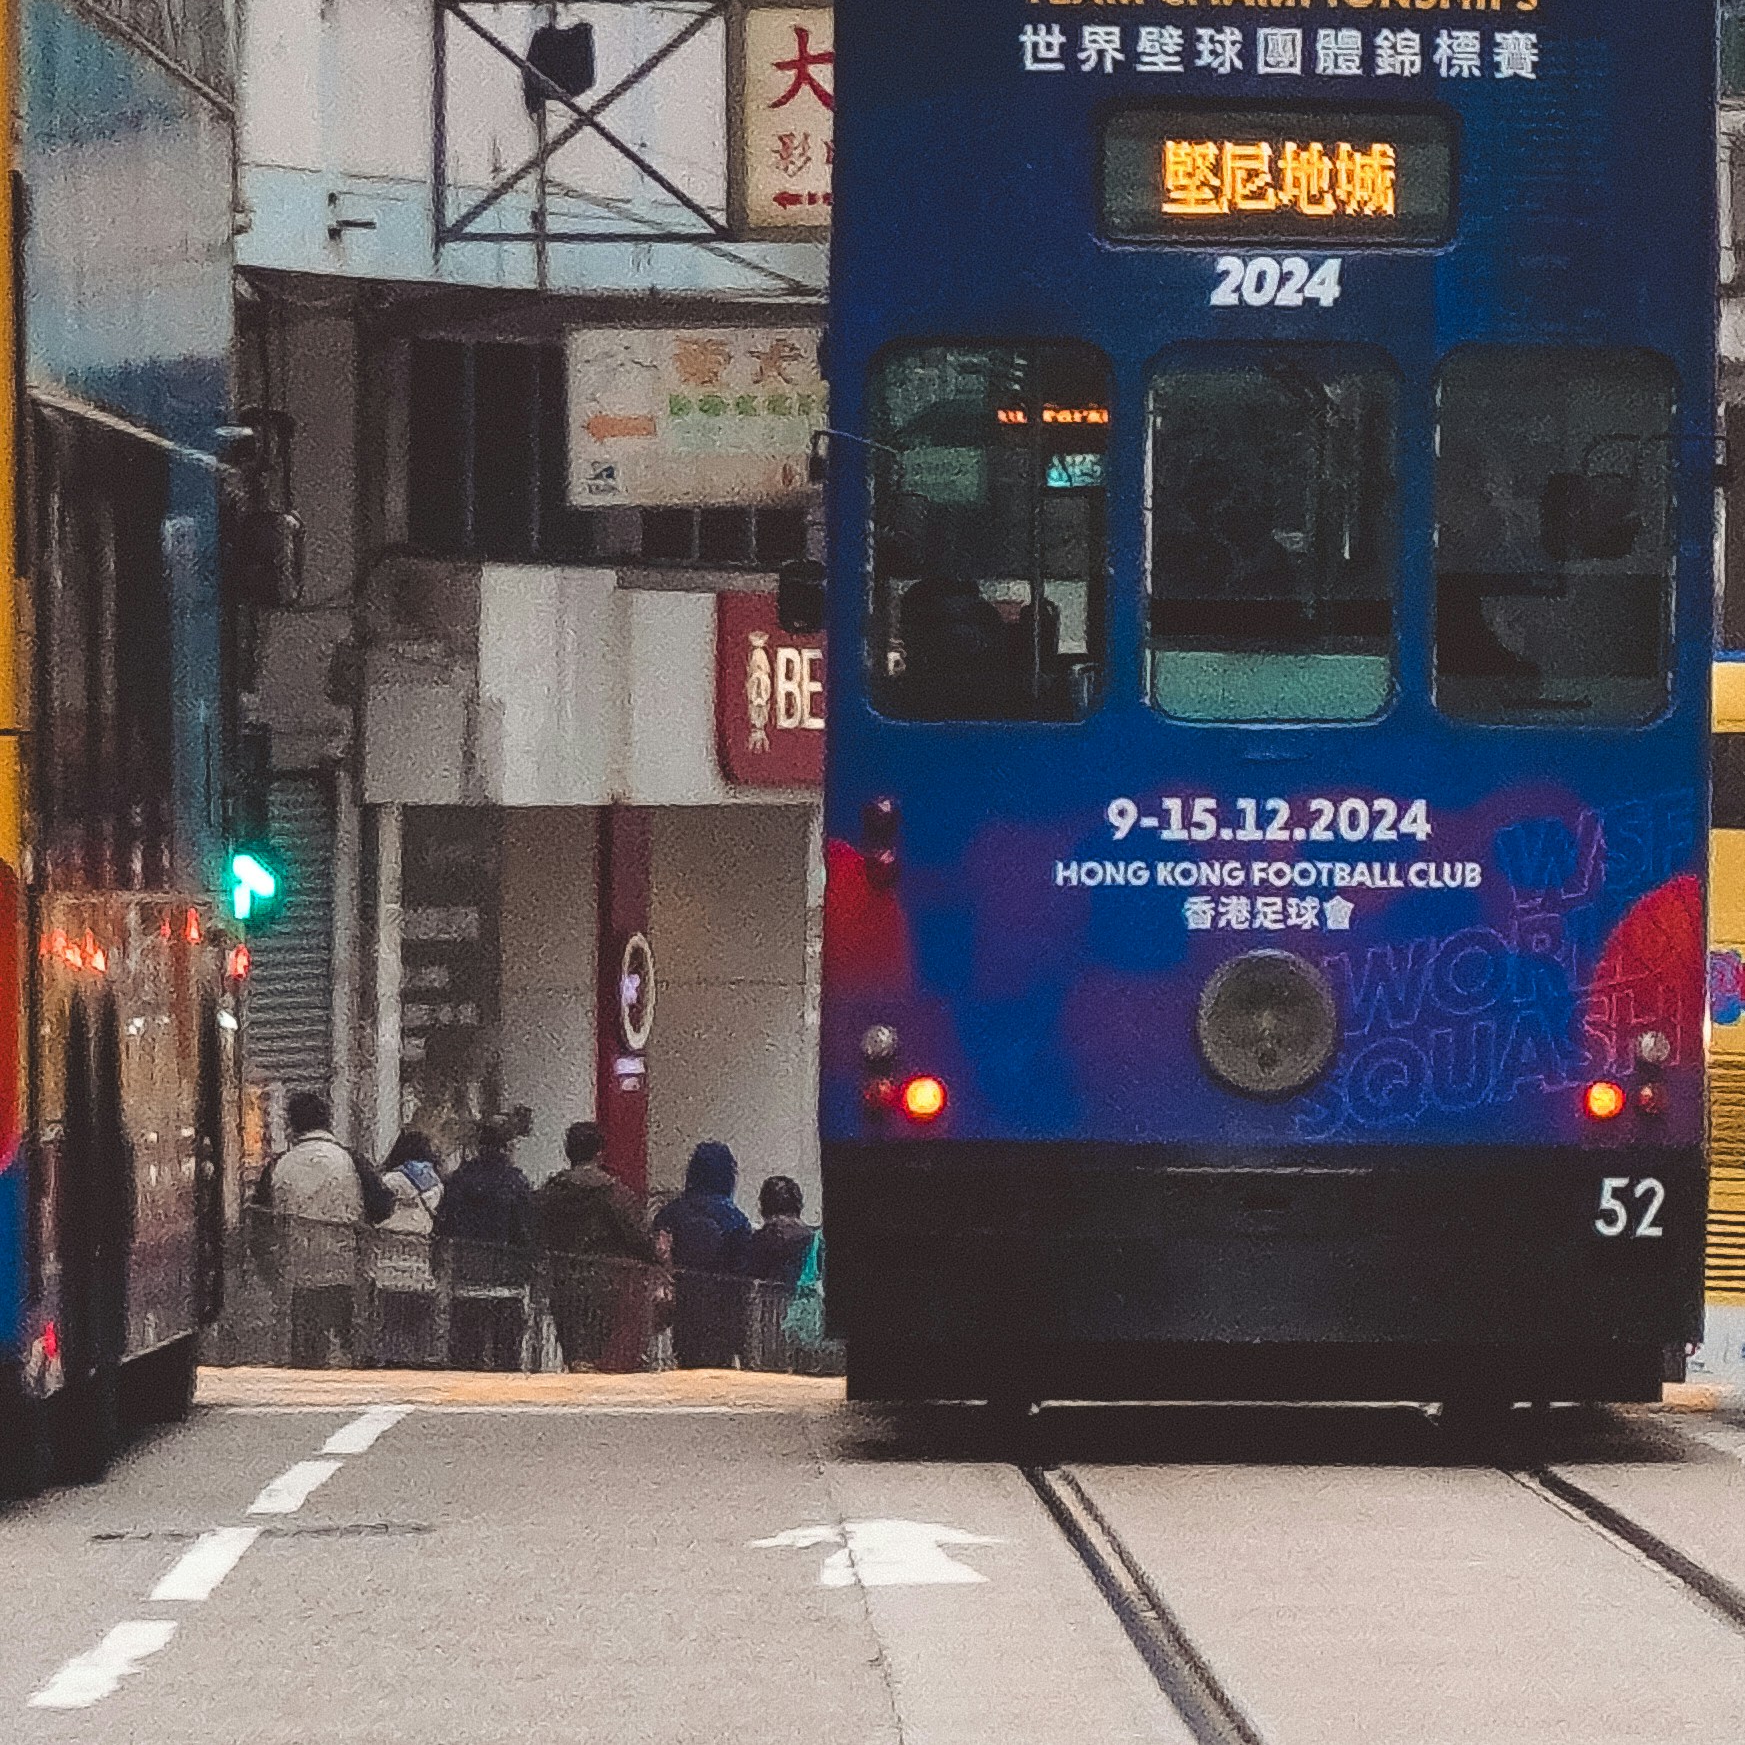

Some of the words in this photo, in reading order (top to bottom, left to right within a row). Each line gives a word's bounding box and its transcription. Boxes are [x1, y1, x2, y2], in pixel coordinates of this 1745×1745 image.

[1019, 23, 1538, 79] 世界壁球團體錦標賽
[1162, 140, 1396, 216] 堅尼地城
[1210, 256, 1342, 307] 2024
[1106, 798, 1432, 842] 9-15.12.2024
[1055, 860, 1150, 887] HONG
[1157, 861, 1246, 887] KONG
[1252, 861, 1404, 888] FOOTBALL
[1407, 862, 1482, 888] CLUB
[1183, 895, 1355, 930] 香港足球會
[1594, 1177, 1665, 1237] 52
